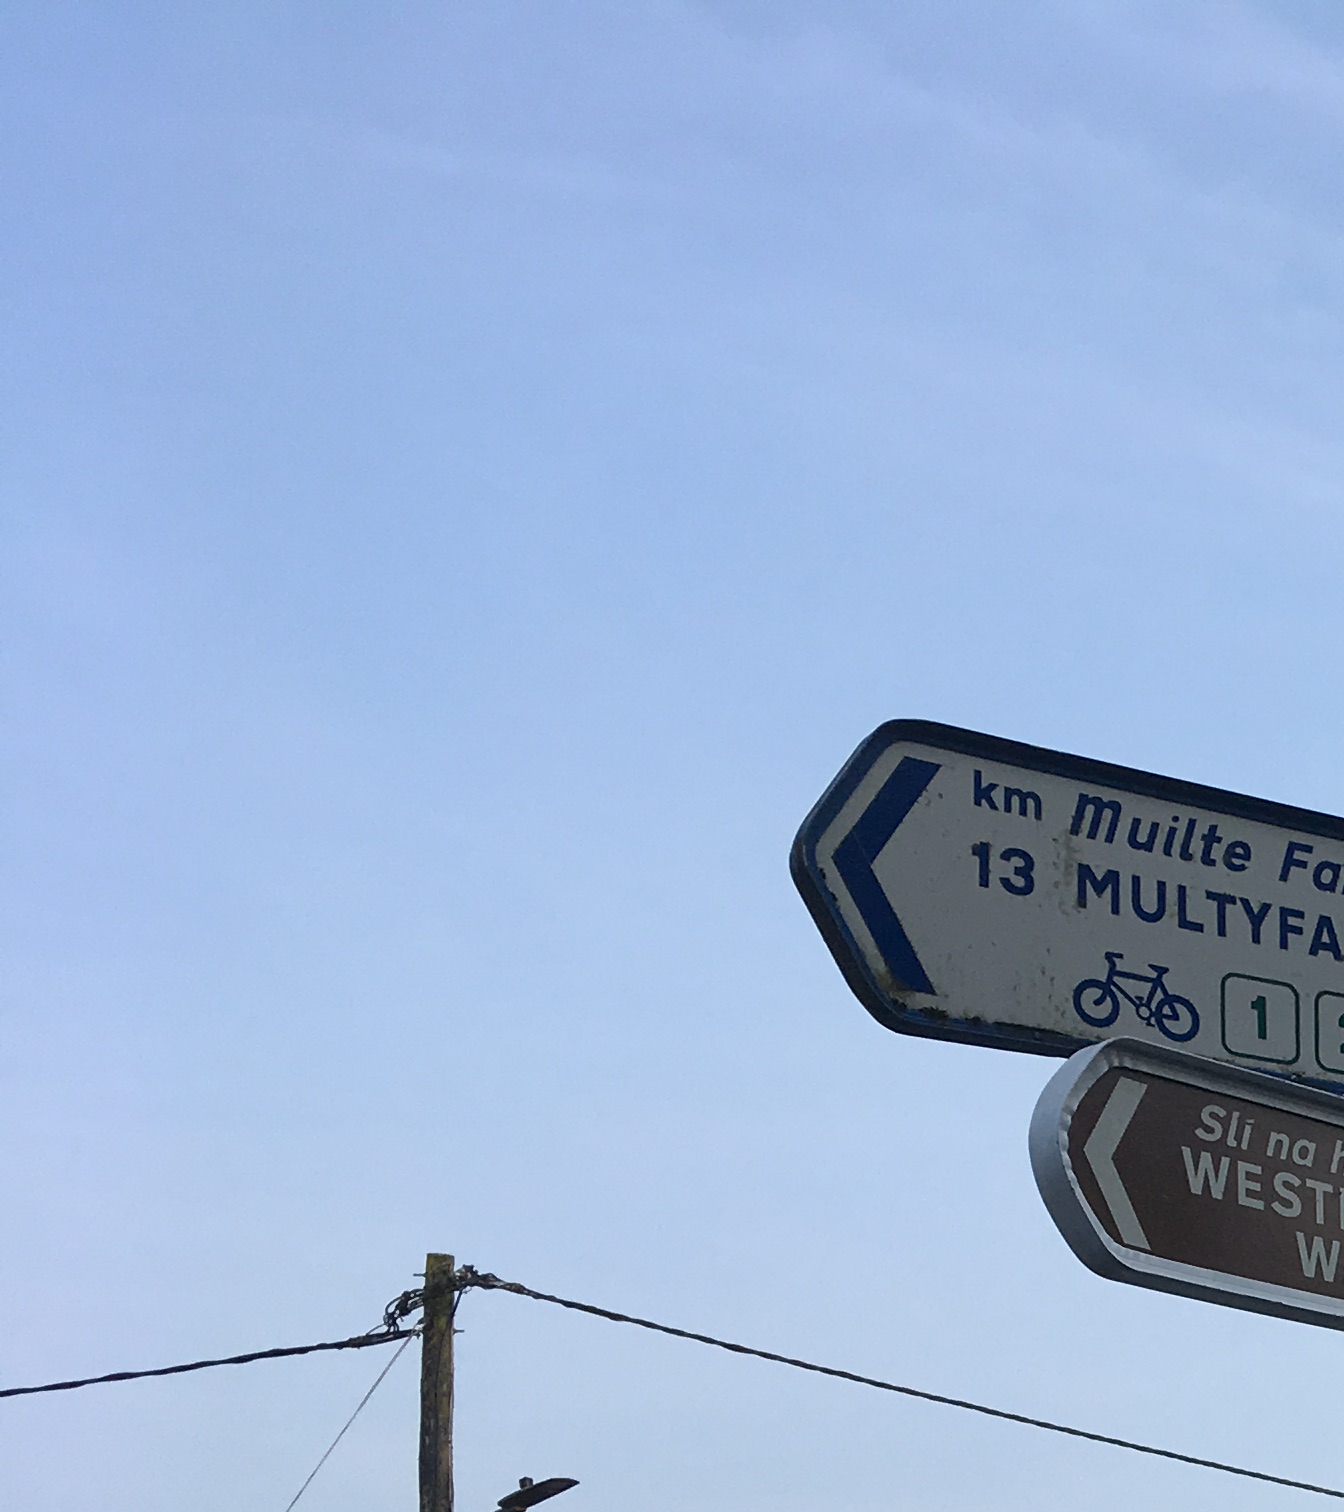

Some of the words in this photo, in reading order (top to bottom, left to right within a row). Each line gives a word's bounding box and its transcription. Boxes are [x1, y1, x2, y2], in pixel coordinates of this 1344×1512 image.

[972, 769, 1043, 821] km
[1069, 793, 1251, 872] Muilte
[971, 841, 1035, 896] 13
[1250, 995, 1267, 1040] 1
[1194, 1104, 1255, 1150] Slí
[1266, 1130, 1316, 1168] na
